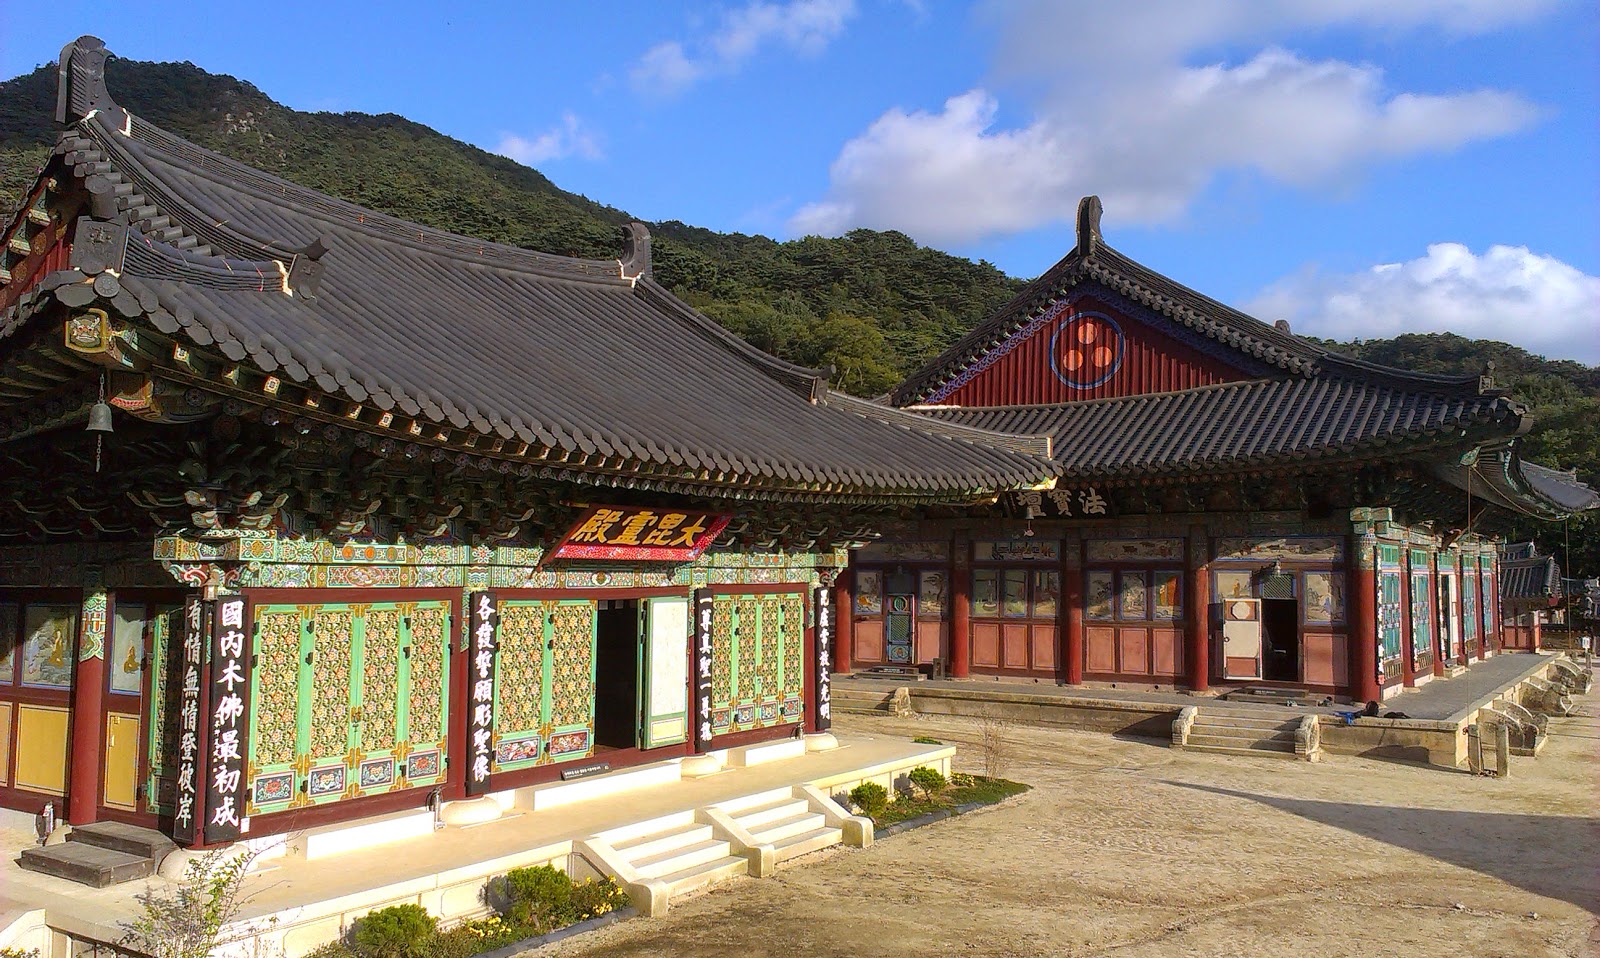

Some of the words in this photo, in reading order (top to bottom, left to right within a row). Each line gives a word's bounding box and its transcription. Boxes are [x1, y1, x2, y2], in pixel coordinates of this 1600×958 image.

[175, 599, 203, 829] 有情無情登彼岸
